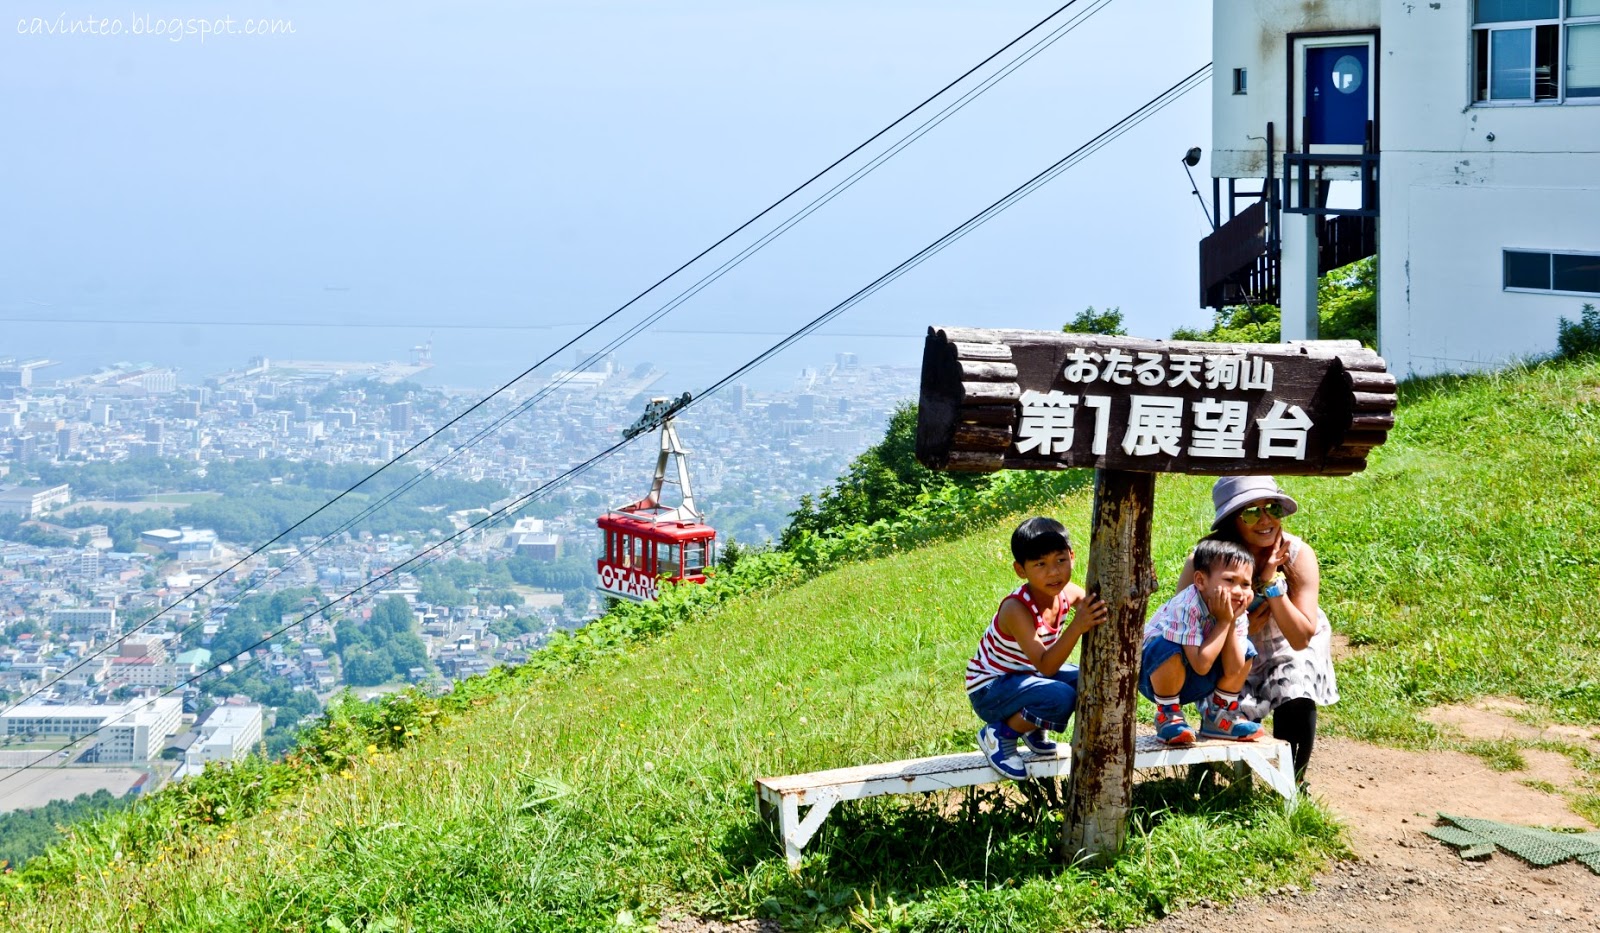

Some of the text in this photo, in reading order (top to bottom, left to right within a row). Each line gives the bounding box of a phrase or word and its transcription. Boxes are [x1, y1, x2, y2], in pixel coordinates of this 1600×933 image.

[1064, 348, 1274, 391] おたる天狗山
[1015, 390, 1314, 460] 第1展望台
[1218, 718, 1232, 731] N
